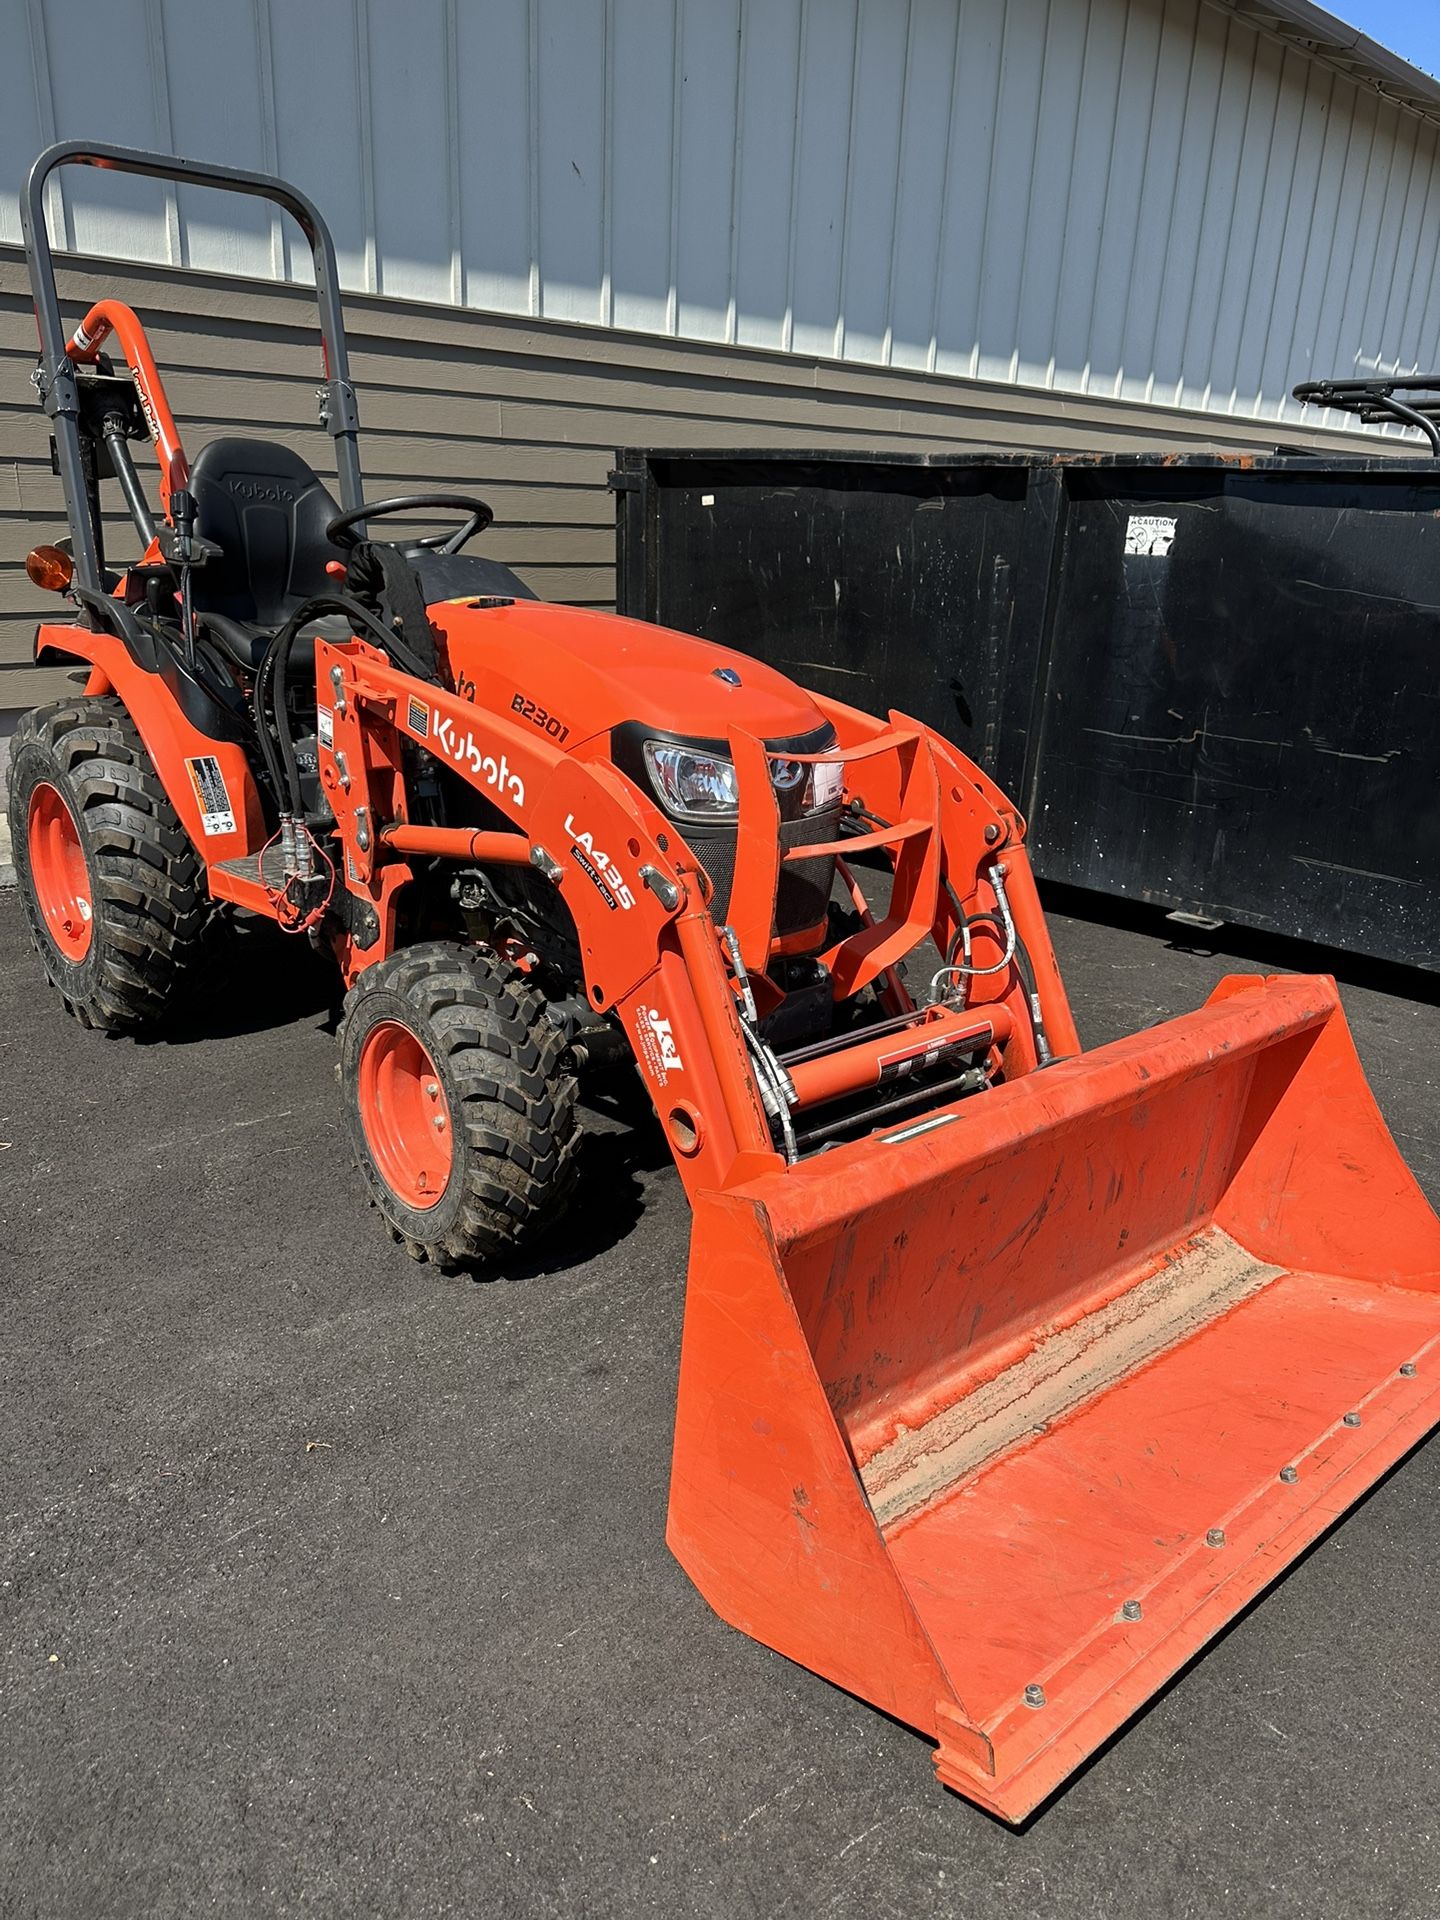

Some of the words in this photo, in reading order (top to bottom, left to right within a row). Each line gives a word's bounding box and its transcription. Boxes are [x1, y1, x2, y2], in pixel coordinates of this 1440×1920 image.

[229, 480, 294, 502] Kubota
[1137, 518, 1174, 526] CAUTION
[511, 693, 570, 743] B2301
[433, 709, 525, 807] Kubota
[564, 813, 637, 910] LA435
[572, 848, 615, 908] Swift-Tach
[648, 1009, 684, 1072] J&I
